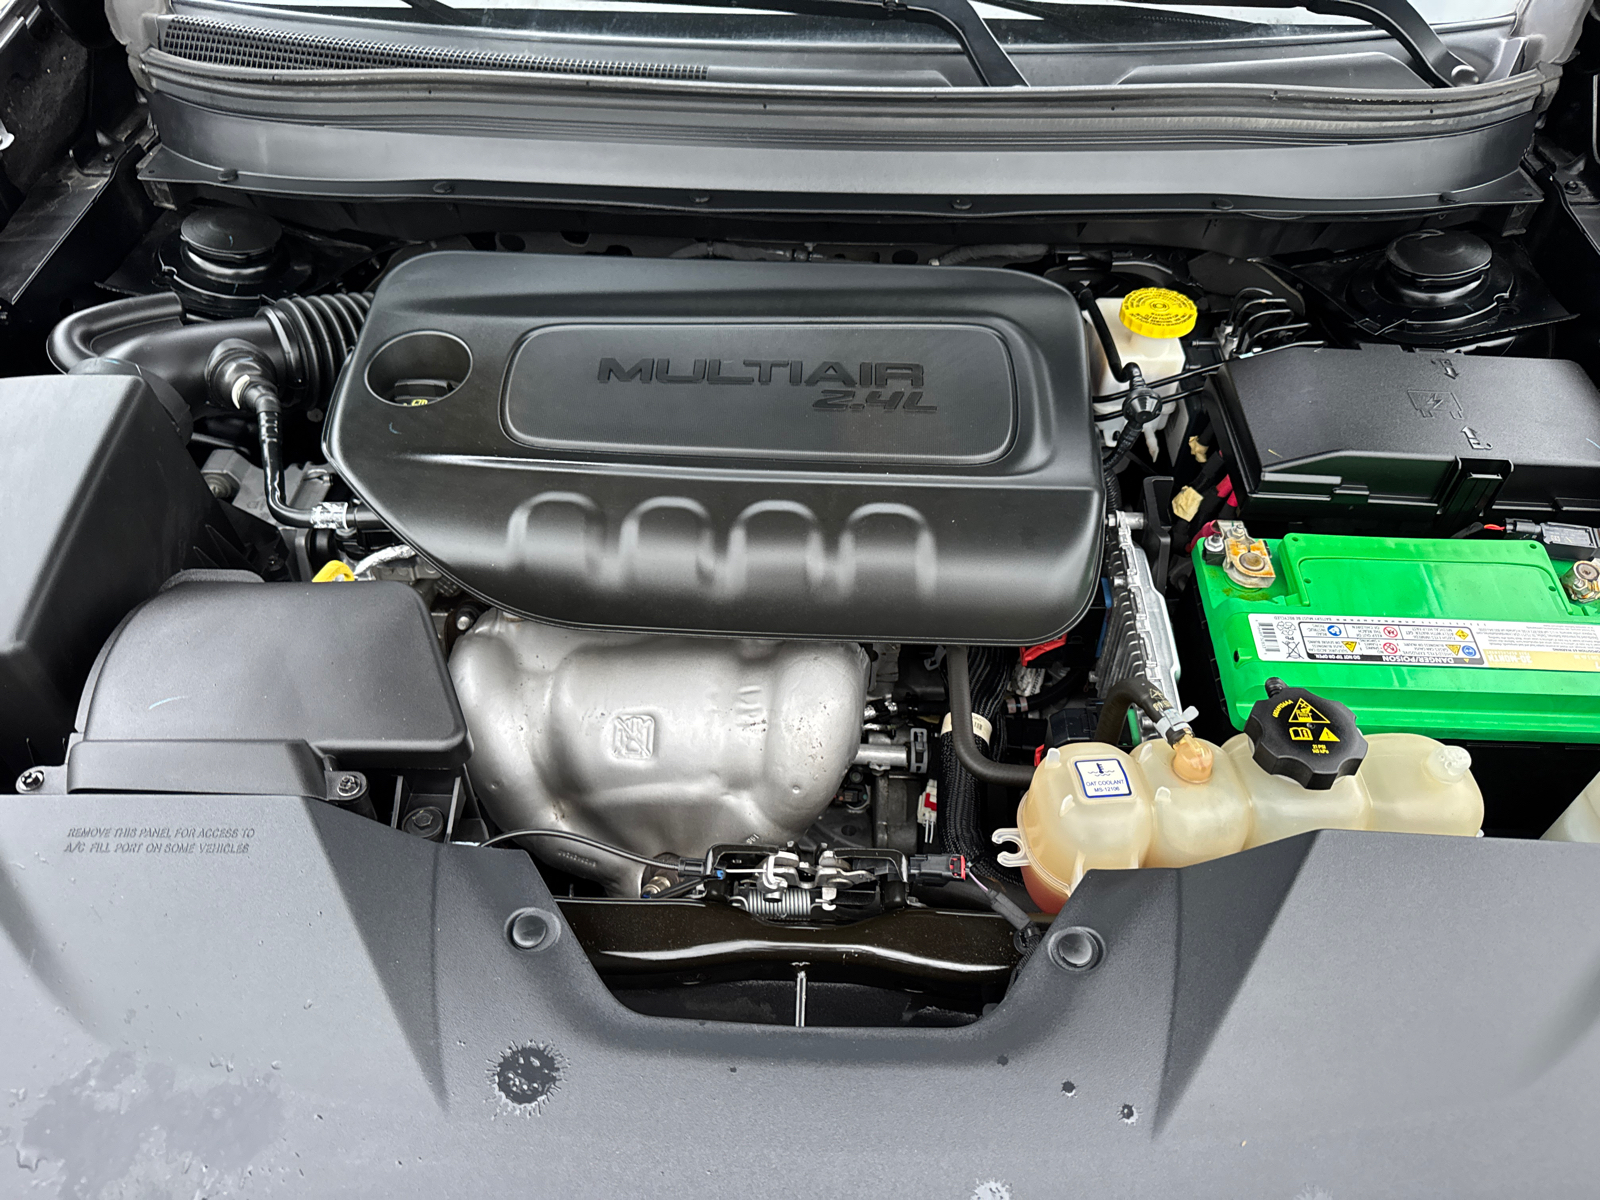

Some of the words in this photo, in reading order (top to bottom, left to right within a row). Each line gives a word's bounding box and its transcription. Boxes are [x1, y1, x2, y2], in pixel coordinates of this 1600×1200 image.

[597, 357, 925, 387] MULTIAIR
[812, 388, 938, 412] 2.4L
[1382, 655, 1455, 664] DANGER/POISON
[67, 827, 111, 838] REMOVE
[114, 827, 137, 838] THIS
[139, 827, 172, 838] PANEL
[174, 827, 196, 838] FOR
[196, 827, 238, 838] ACCESS
[241, 828, 256, 838] TO
[64, 841, 85, 853] A/C
[89, 842, 110, 853] FILL
[114, 842, 143, 853] PORT
[145, 842, 162, 853] ON
[164, 842, 196, 854] SOME
[199, 842, 250, 854] VEHICLES
